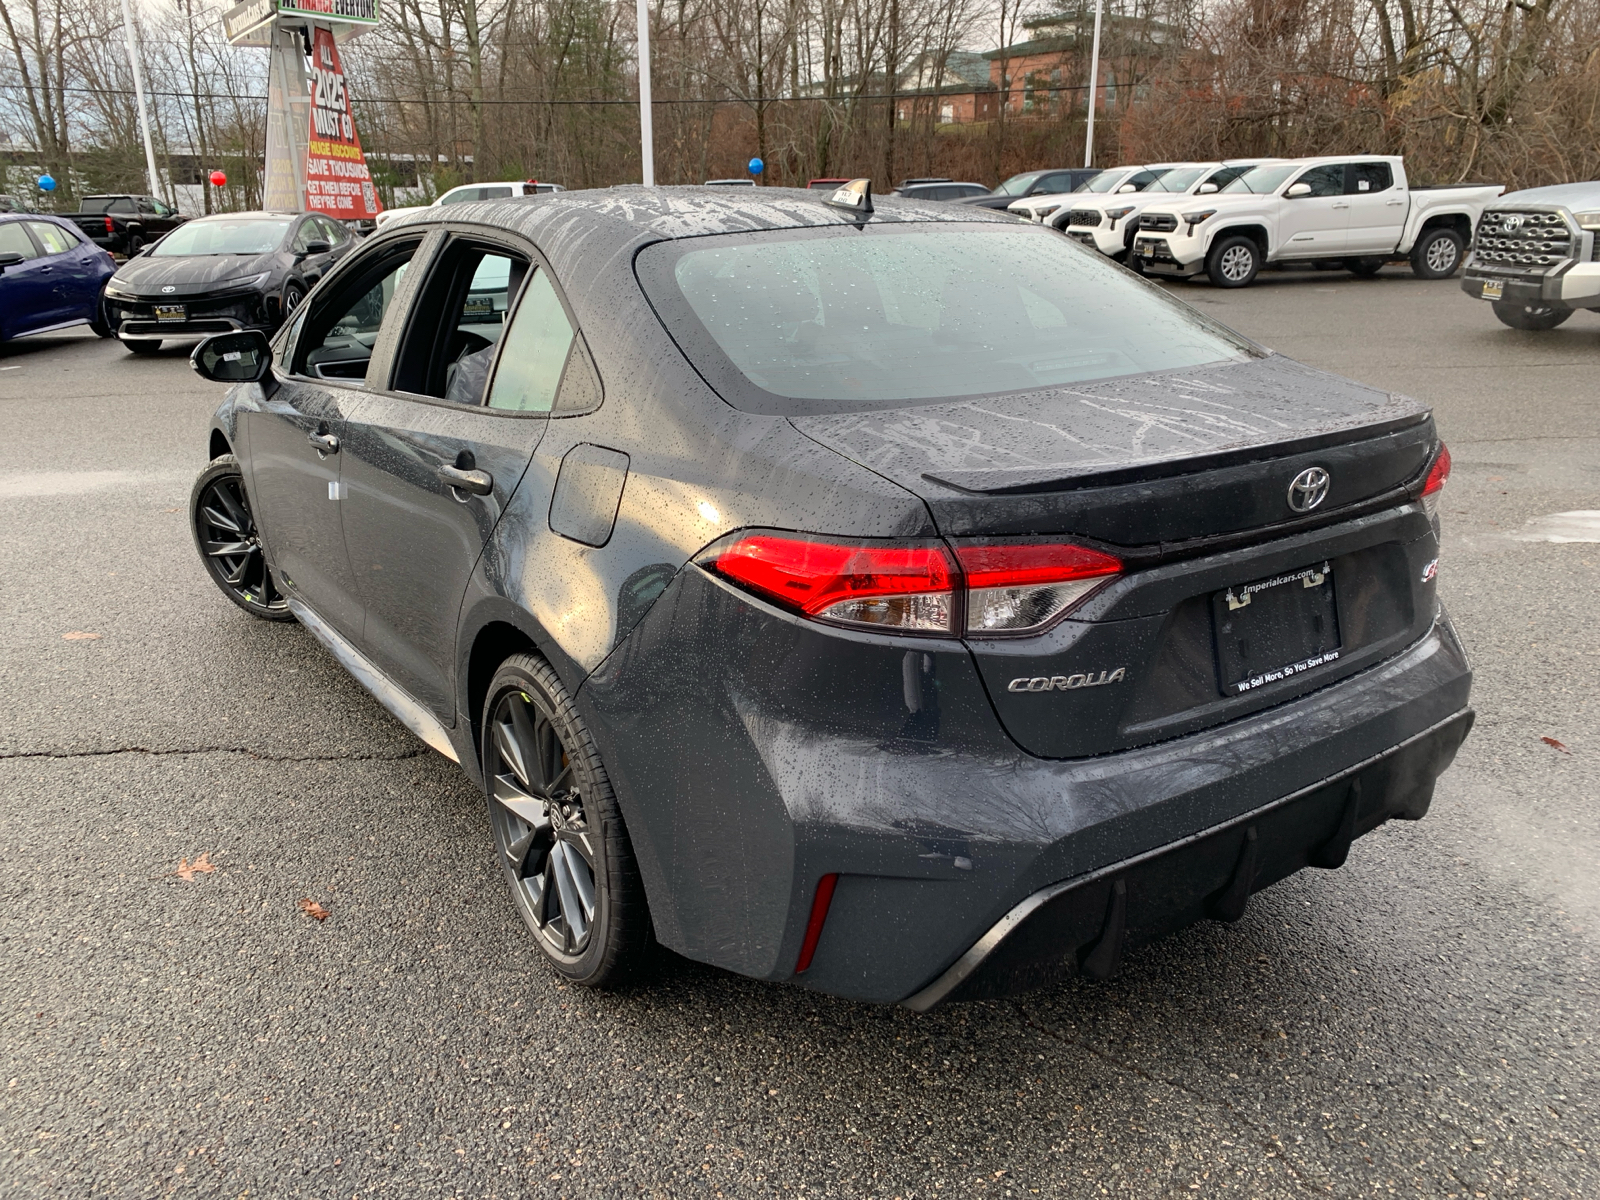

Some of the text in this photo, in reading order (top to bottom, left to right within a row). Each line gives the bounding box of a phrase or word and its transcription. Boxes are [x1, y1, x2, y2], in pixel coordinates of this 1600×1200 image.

[336, 0, 376, 19] EVERYONE
[320, 44, 333, 66] ALL
[313, 67, 346, 111] 2025
[312, 107, 340, 137] MUST
[341, 113, 353, 139] GO
[310, 141, 361, 160] HUGE DISCOUNTS
[308, 158, 329, 175] SAVE
[307, 180, 361, 196] GET THEM BEFORE
[309, 195, 354, 209] THEY'RE GONE
[1243, 569, 1314, 594] Imperialcars.com
[1007, 667, 1126, 692] COROLLA
[1238, 651, 1339, 692] We Sell More, So You Save More
